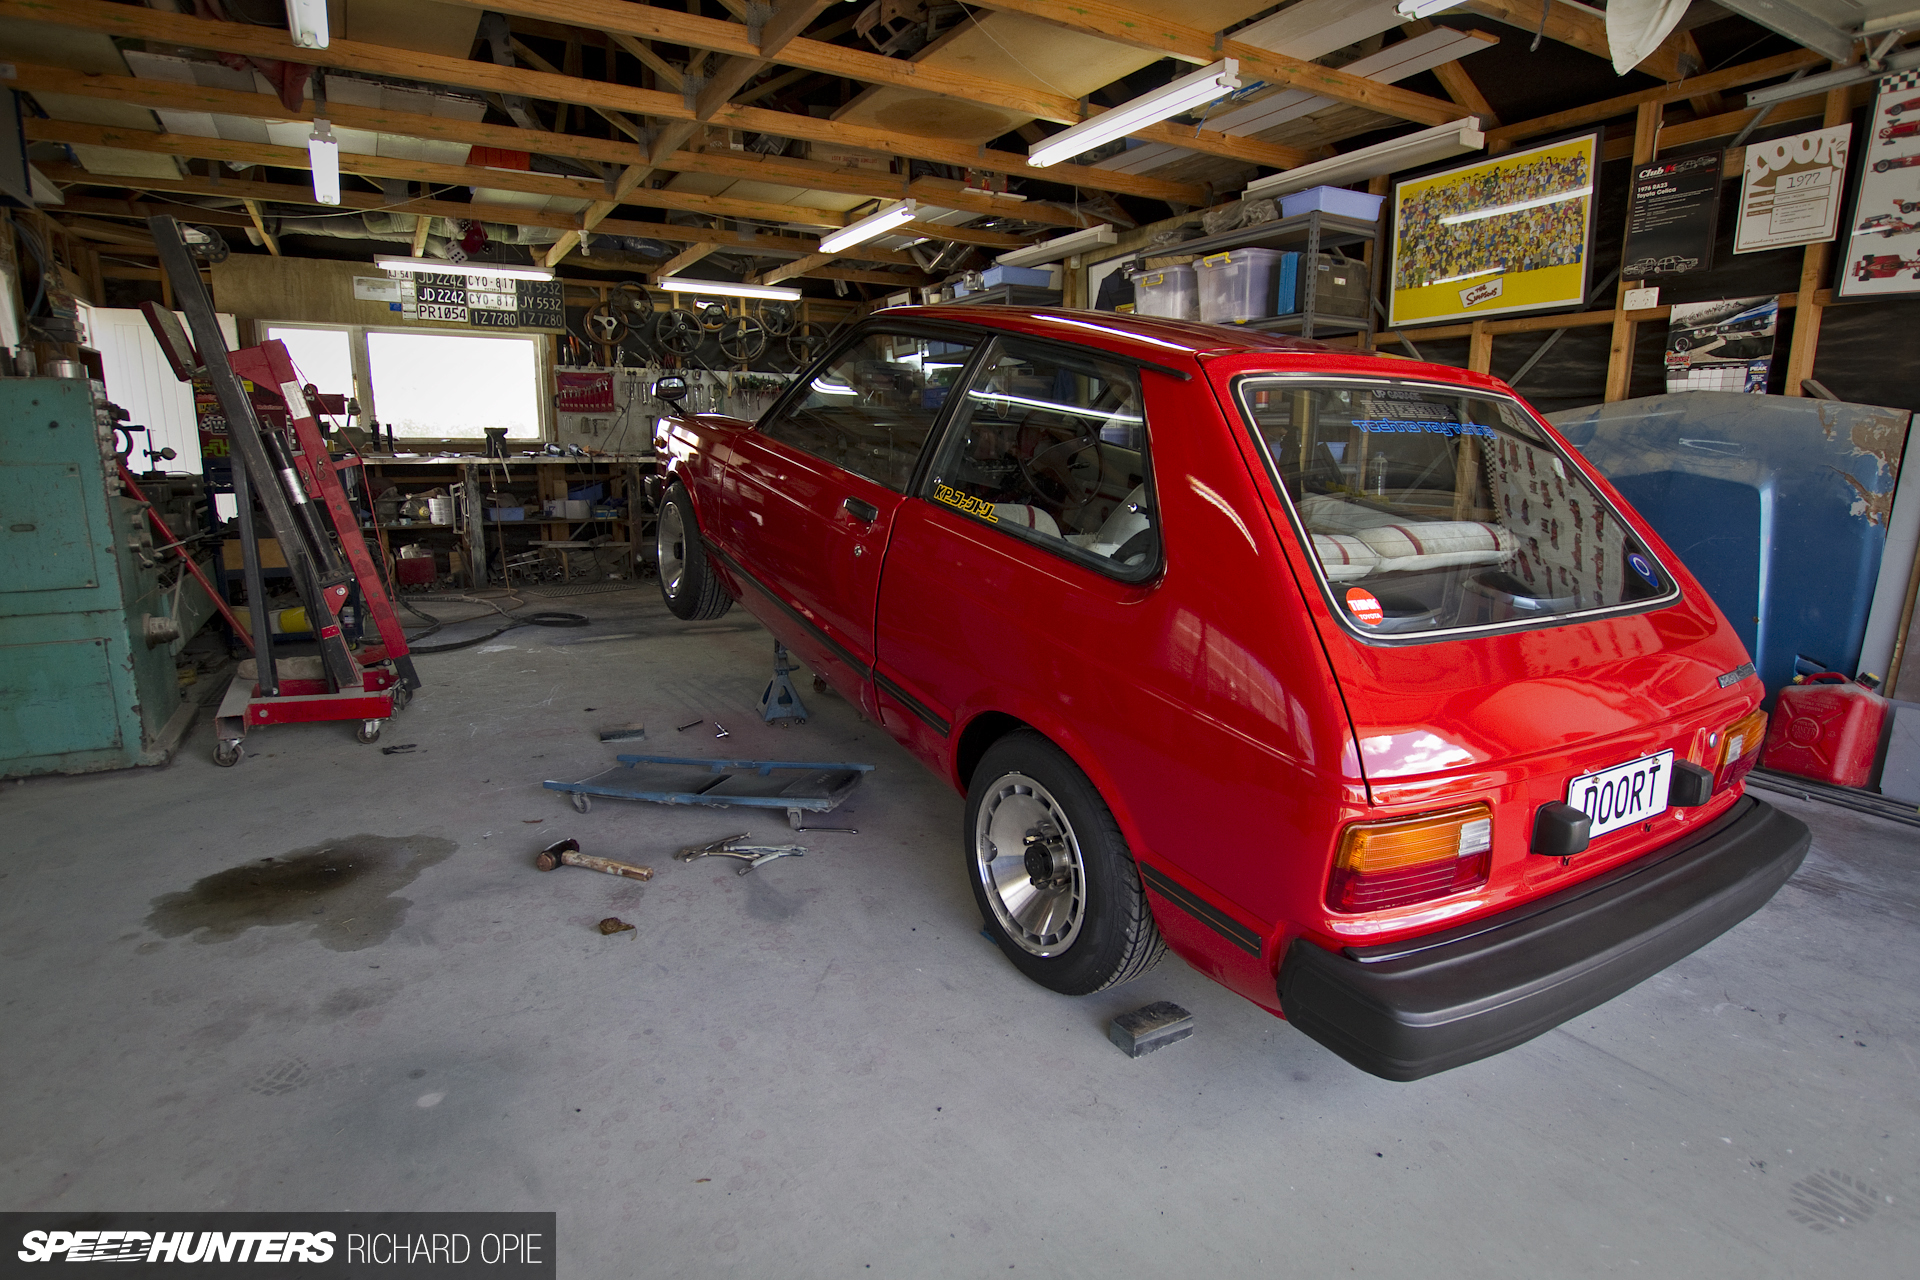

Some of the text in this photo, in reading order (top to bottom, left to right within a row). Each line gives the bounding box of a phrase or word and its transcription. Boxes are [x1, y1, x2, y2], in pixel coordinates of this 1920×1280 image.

[1639, 166, 1665, 179] Club
[1787, 172, 1821, 189] 1977
[1637, 190, 1656, 199] Toyota
[1656, 187, 1677, 196] Celica
[1638, 182, 1669, 194] 1976 RA23
[419, 305, 467, 321] PR1054
[1372, 389, 1423, 401] UP GARAGE
[1358, 612, 1384, 620] TOYOTA
